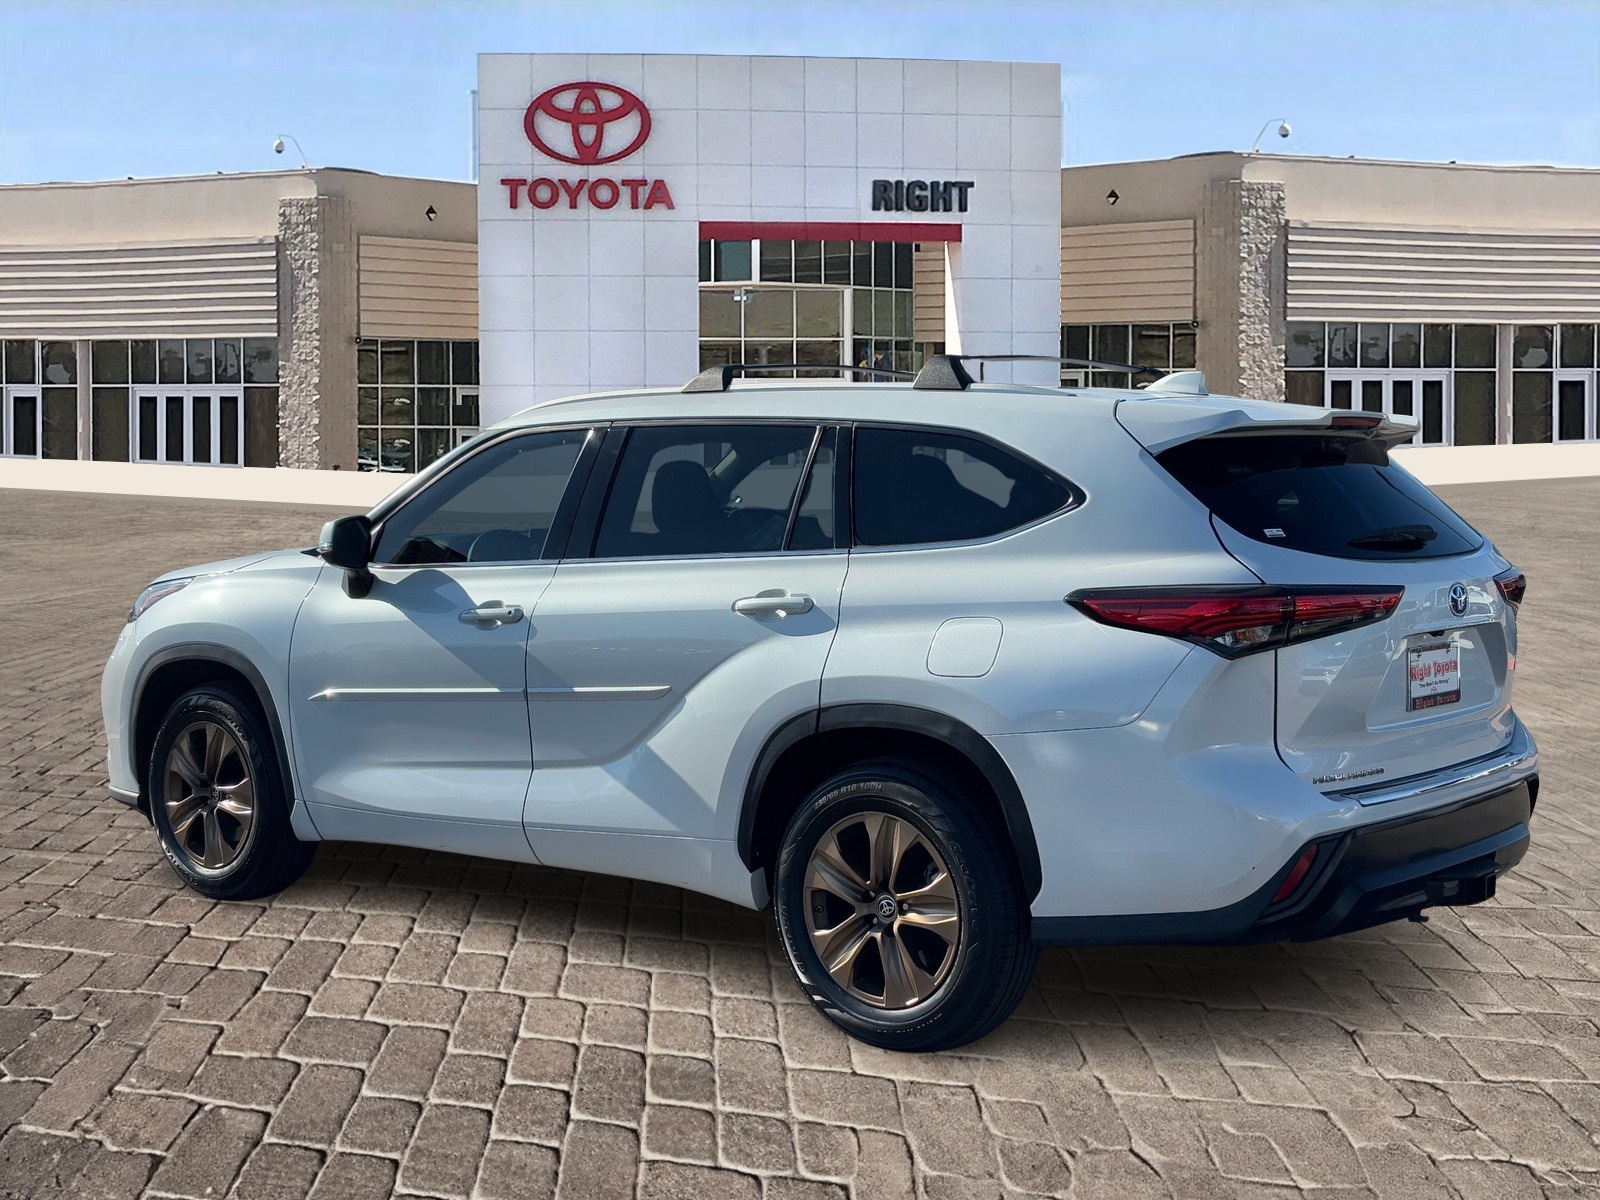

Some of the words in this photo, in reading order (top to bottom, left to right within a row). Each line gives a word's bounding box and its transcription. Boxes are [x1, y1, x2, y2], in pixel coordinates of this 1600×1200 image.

[500, 177, 675, 210] TOYOTA
[872, 179, 975, 212] RIGHT
[1411, 663, 1431, 682] Right
[1433, 660, 1458, 678] Toyota
